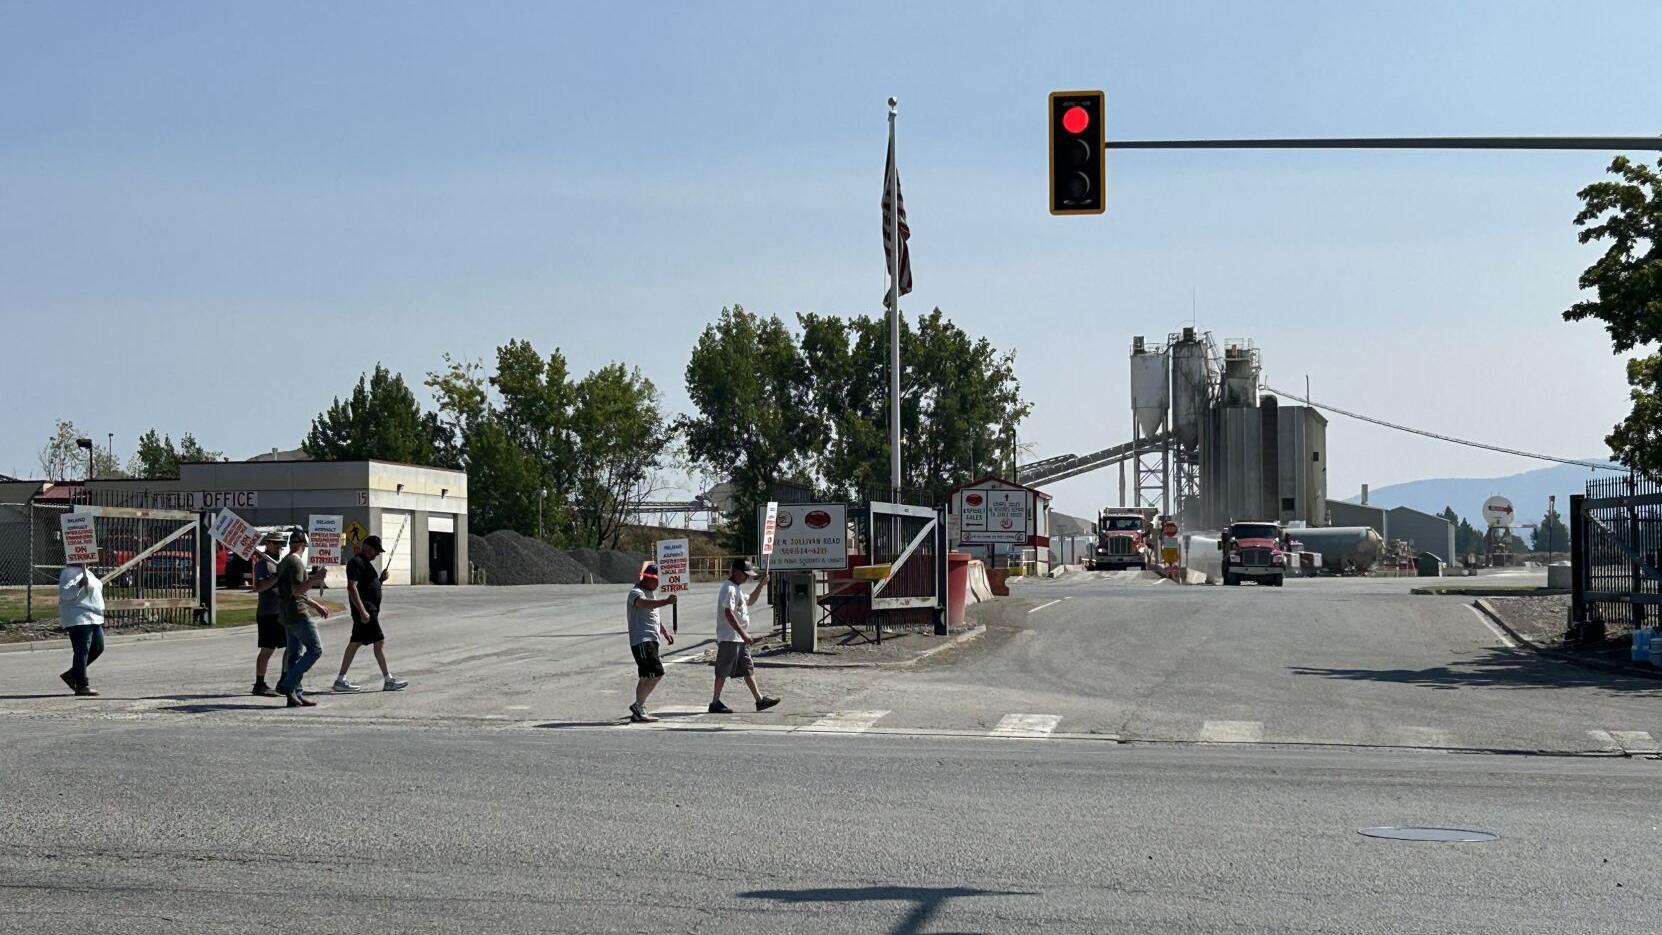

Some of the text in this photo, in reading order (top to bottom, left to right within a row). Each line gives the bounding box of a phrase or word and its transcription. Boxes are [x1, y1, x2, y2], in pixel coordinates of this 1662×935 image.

[203, 492, 254, 507] OFFICE
[67, 553, 97, 561] STRIKE
[311, 556, 339, 564] STRIKE
[661, 584, 689, 592] STRIKE
